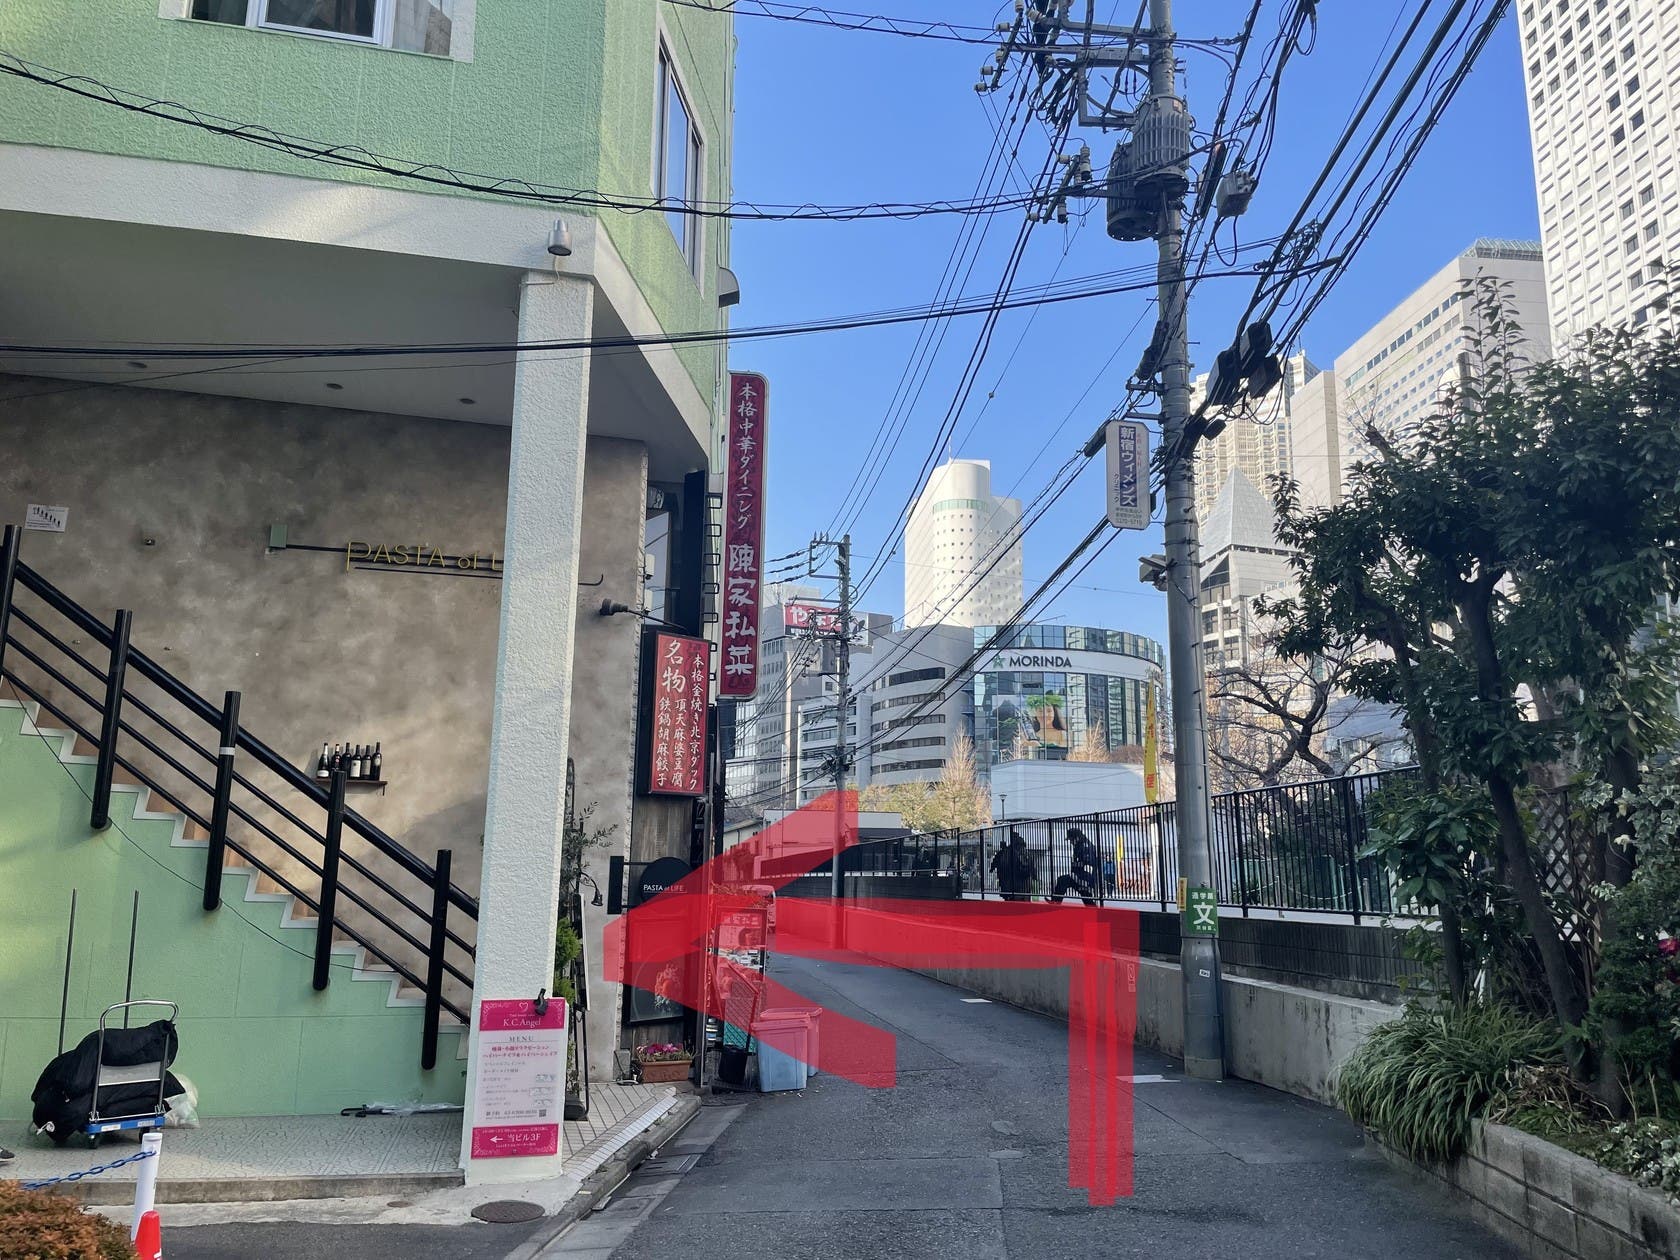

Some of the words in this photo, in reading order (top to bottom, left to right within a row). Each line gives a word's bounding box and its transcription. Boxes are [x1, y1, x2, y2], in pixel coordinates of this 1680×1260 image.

[736, 383, 758, 529] 本格中華ダイニング
[1120, 426, 1136, 507] 新宿ウィメンズ
[346, 542, 446, 572] PASTA
[725, 544, 758, 676] 陳家私菜
[661, 640, 686, 693] 名物
[1009, 655, 1072, 668] MORINDA
[655, 696, 672, 787] 鉄鍋胡麻餃子
[671, 698, 687, 788] 頂天麻婆豆腐
[689, 653, 705, 791] 本格釜焼き北京ダック
[1193, 902, 1215, 925] 文
